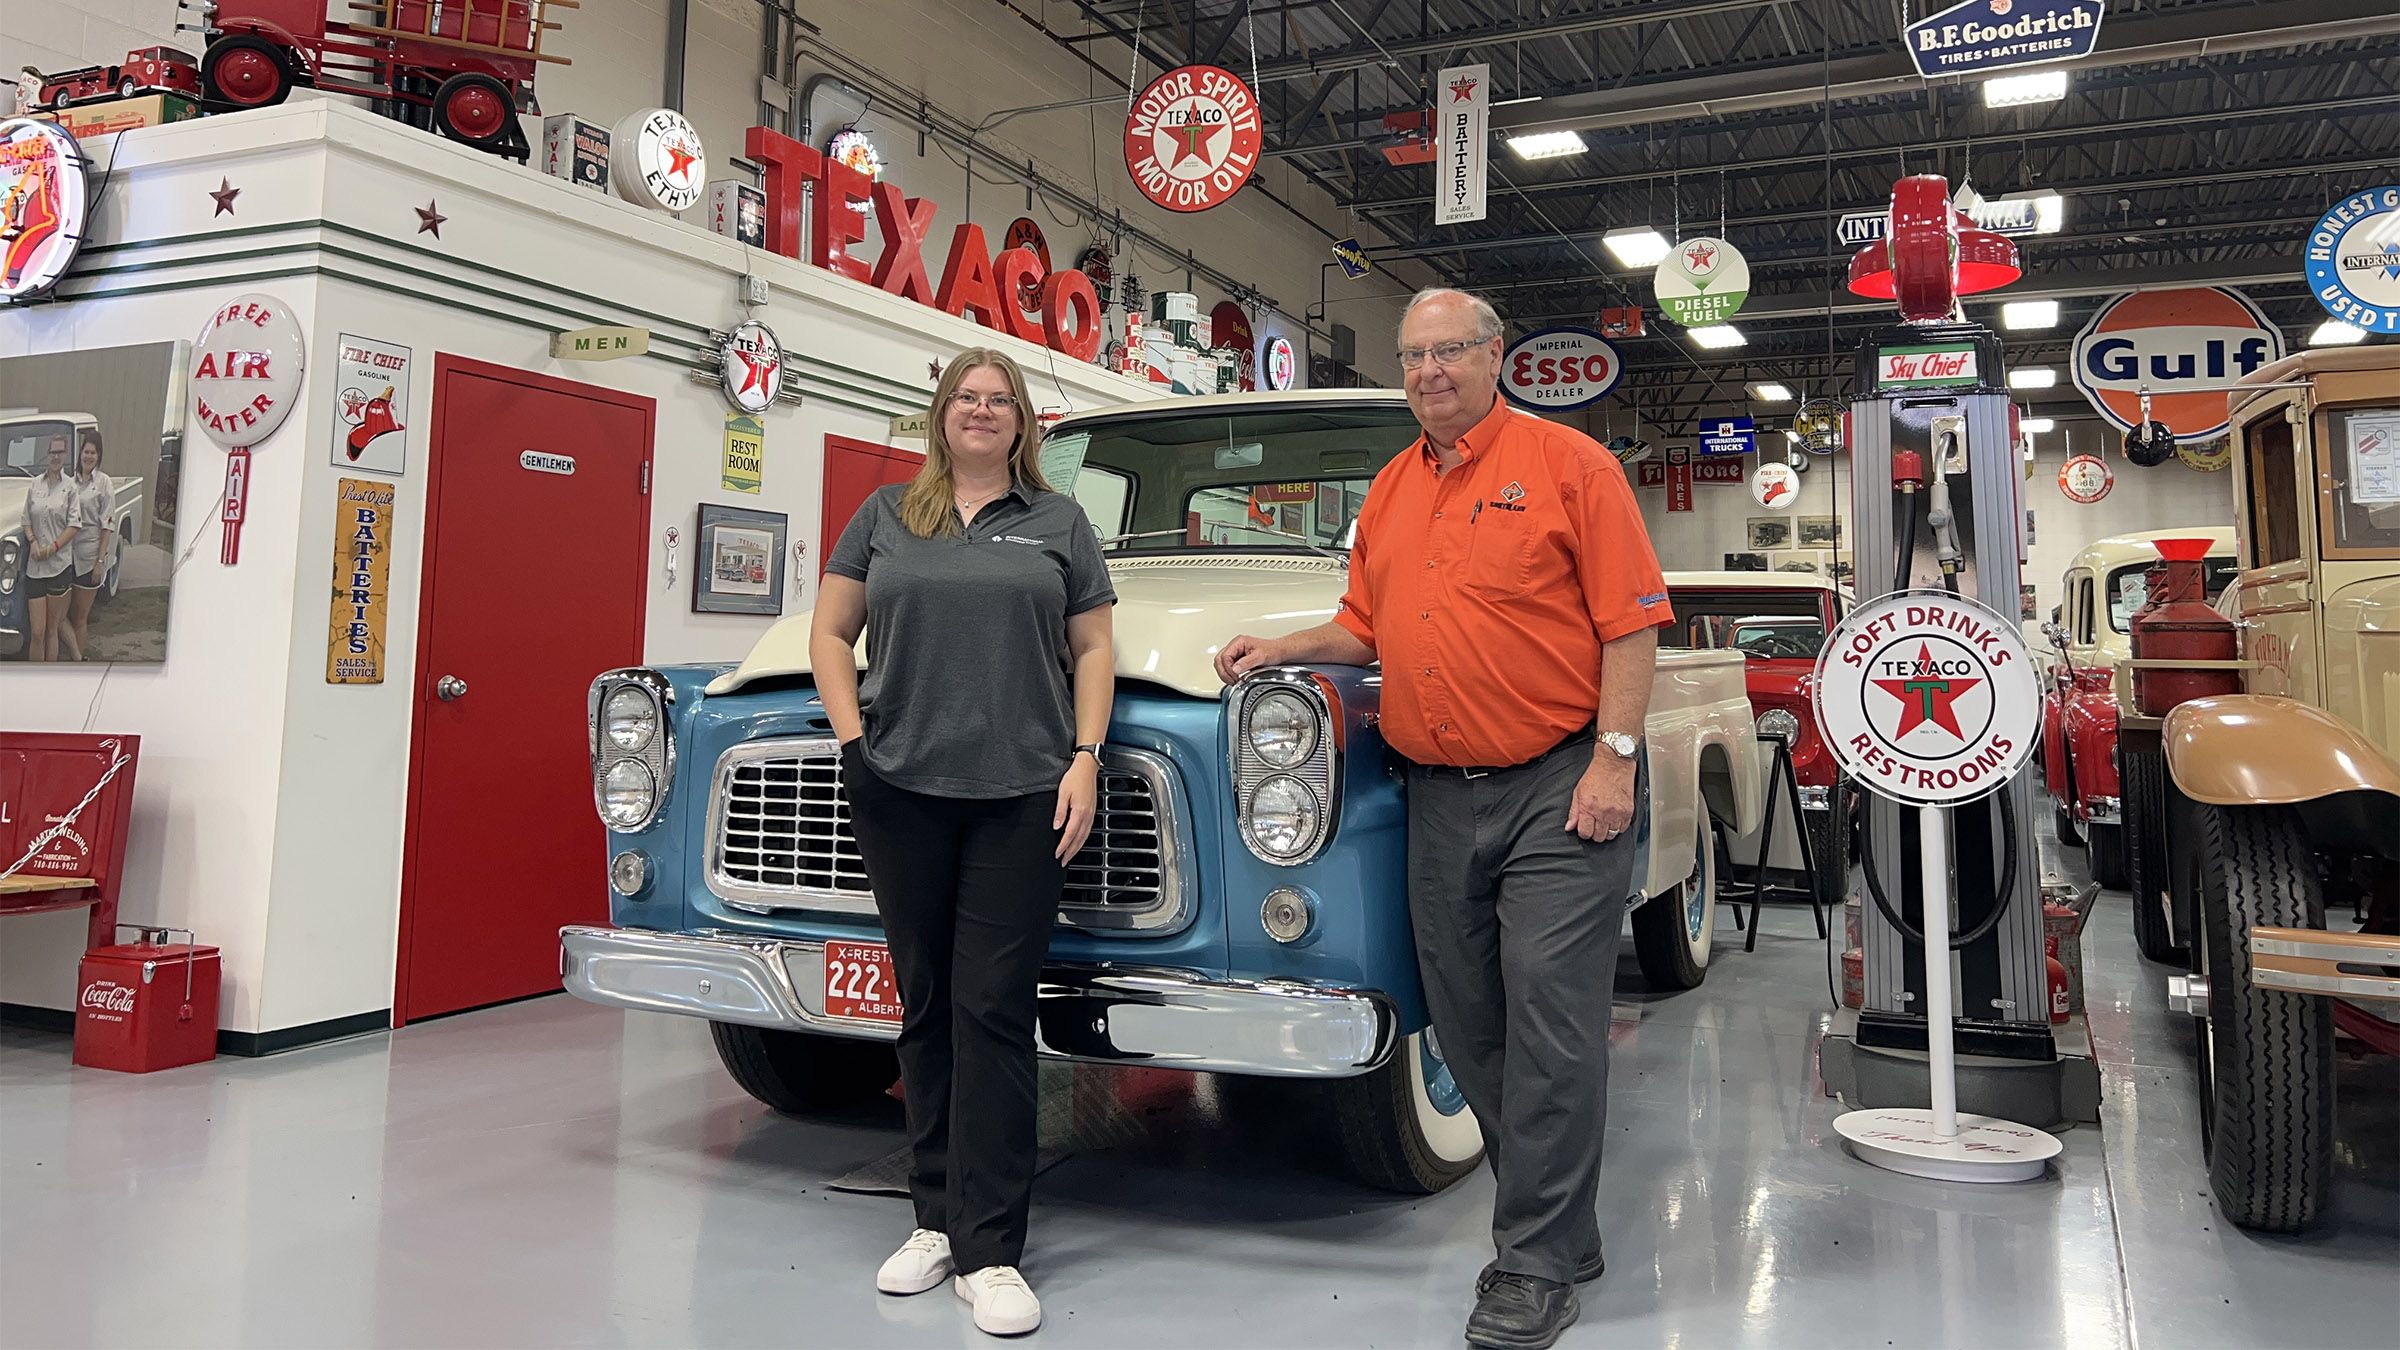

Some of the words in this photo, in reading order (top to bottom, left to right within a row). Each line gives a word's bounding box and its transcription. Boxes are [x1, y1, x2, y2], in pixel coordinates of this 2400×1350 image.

[1939, 50, 1983, 65] TIRES
[1991, 37, 2073, 58] BATTERIES
[1131, 72, 1195, 137] MOTOR
[1200, 71, 1257, 132] SPIRIT
[1167, 108, 1222, 125] TEXACO
[645, 113, 703, 161] TEXACO
[550, 141, 559, 176] VAL
[1454, 113, 1468, 205] BATTERY
[646, 170, 698, 207] ETHYL
[1134, 155, 1209, 206] MOTOR
[1212, 151, 1254, 193] OIL
[716, 203, 724, 235] VAL
[1446, 212, 1475, 221] SERVICE
[2310, 193, 2376, 261] HONEST
[745, 126, 1101, 363] TEXACO
[215, 303, 272, 329] FREE
[1675, 296, 1731, 312] DIESEL
[1683, 309, 1723, 323] FUEL
[2320, 284, 2377, 326] USED
[575, 336, 628, 351] MEN
[738, 338, 778, 360] TEXACO
[1536, 340, 1583, 351] IMPERIAL
[194, 351, 272, 379] AIR
[342, 347, 369, 364] FIRE
[373, 352, 406, 371] CHIEF
[1887, 354, 1917, 381] Sky
[1921, 352, 1969, 377] Chief
[2086, 337, 2267, 381] Gulf
[358, 370, 390, 382] GASOLINE
[1536, 388, 1584, 399] DEALER
[198, 393, 274, 432] WATER
[900, 421, 927, 432] LAD
[731, 439, 758, 457] REST
[1705, 437, 1748, 445] INTERNATIONAL
[1710, 443, 1744, 452] TRUCKS
[525, 455, 573, 472] GENTLEMEN
[728, 454, 760, 473] ROOM
[1643, 463, 1740, 482] Fitone
[226, 459, 243, 517] AIR
[1278, 482, 1311, 493] HERE
[1675, 465, 1685, 511] TIRES
[350, 508, 376, 654] BATTERIES
[1842, 611, 1896, 668] SOFT
[1906, 606, 2012, 667] DRINKS
[335, 668, 377, 678] SERVICE
[336, 658, 366, 668] SALES
[1881, 660, 1971, 676] TEXACO
[1850, 733, 2013, 790] RESTROOMS
[54, 841, 61, 851] &
[60, 826, 89, 856] WELDING
[43, 853, 72, 861] FABRICATION
[838, 947, 892, 963] X-REST
[82, 983, 137, 1013] Coca-Cola
